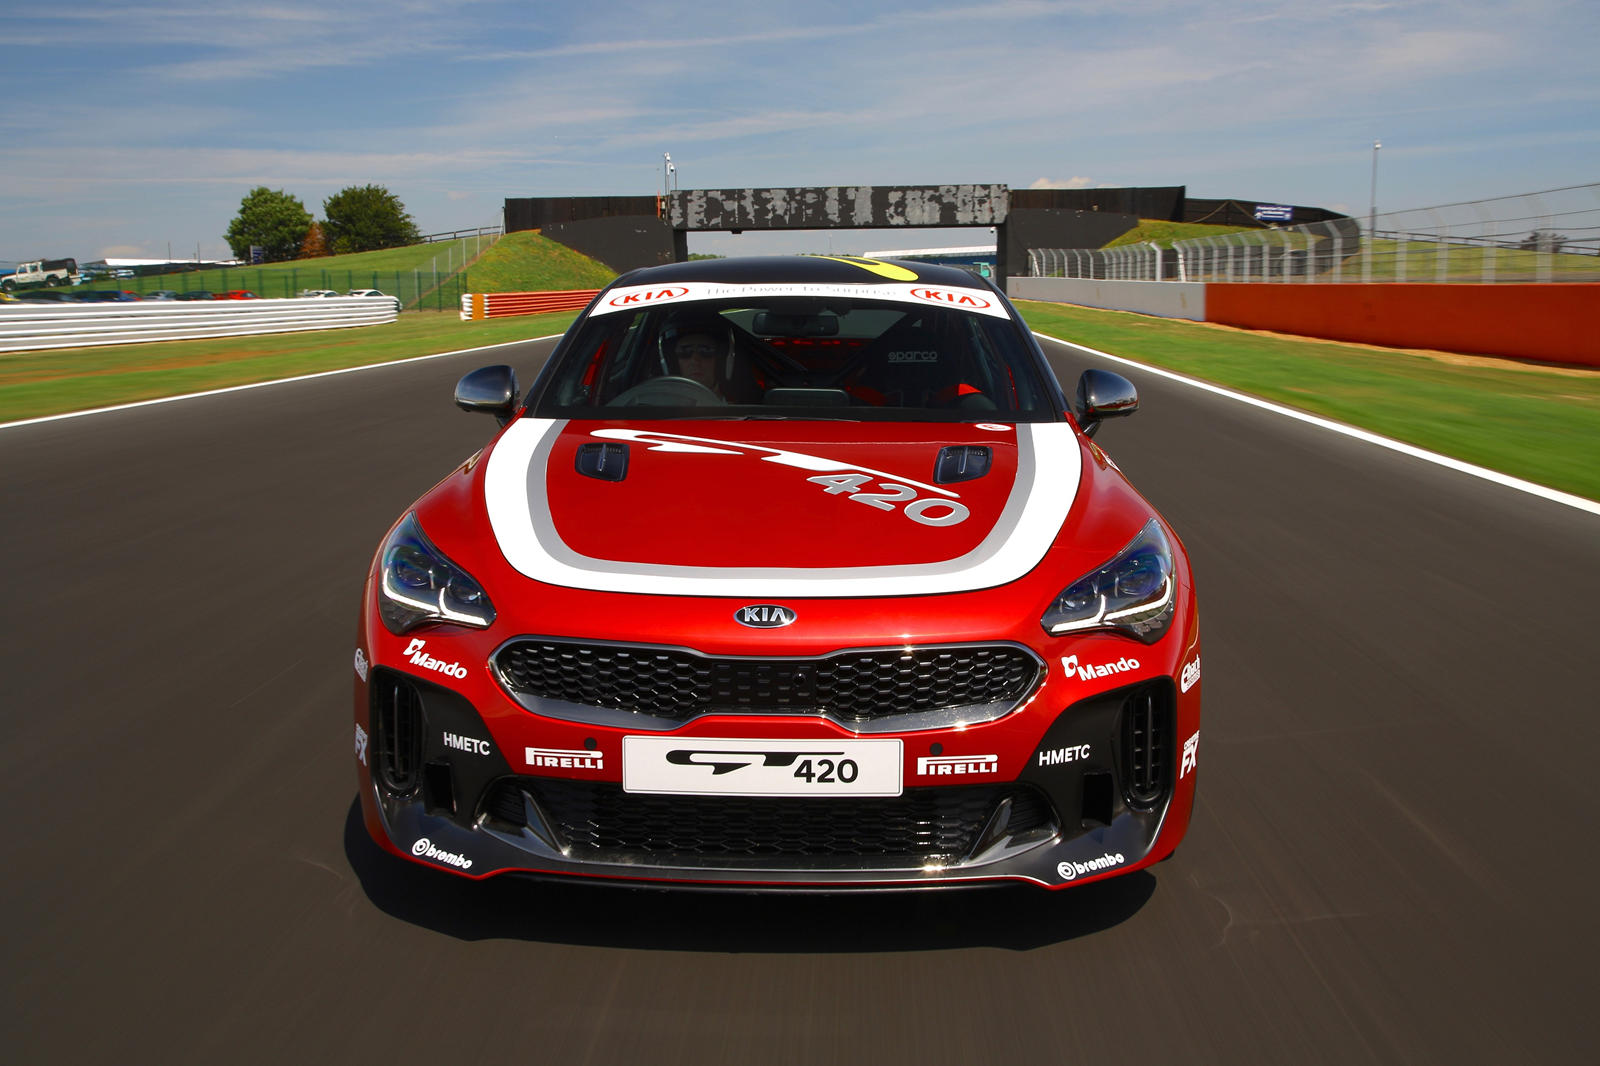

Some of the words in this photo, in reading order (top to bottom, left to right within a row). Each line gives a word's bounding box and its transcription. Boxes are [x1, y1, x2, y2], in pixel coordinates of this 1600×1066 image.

[623, 290, 674, 304] KIA
[925, 290, 977, 306] KIA
[888, 351, 938, 361] sparco
[806, 473, 970, 527] 420
[744, 607, 788, 622] KIA
[409, 651, 468, 679] Mando
[1077, 657, 1140, 682] Mando
[443, 731, 490, 756] HMETC
[525, 747, 603, 770] PIRELLI
[917, 754, 998, 776] PIRELLI
[1038, 744, 1091, 767] HMETC
[794, 759, 859, 784] 420
[425, 844, 473, 869] brembo
[1073, 853, 1125, 875] brembo
